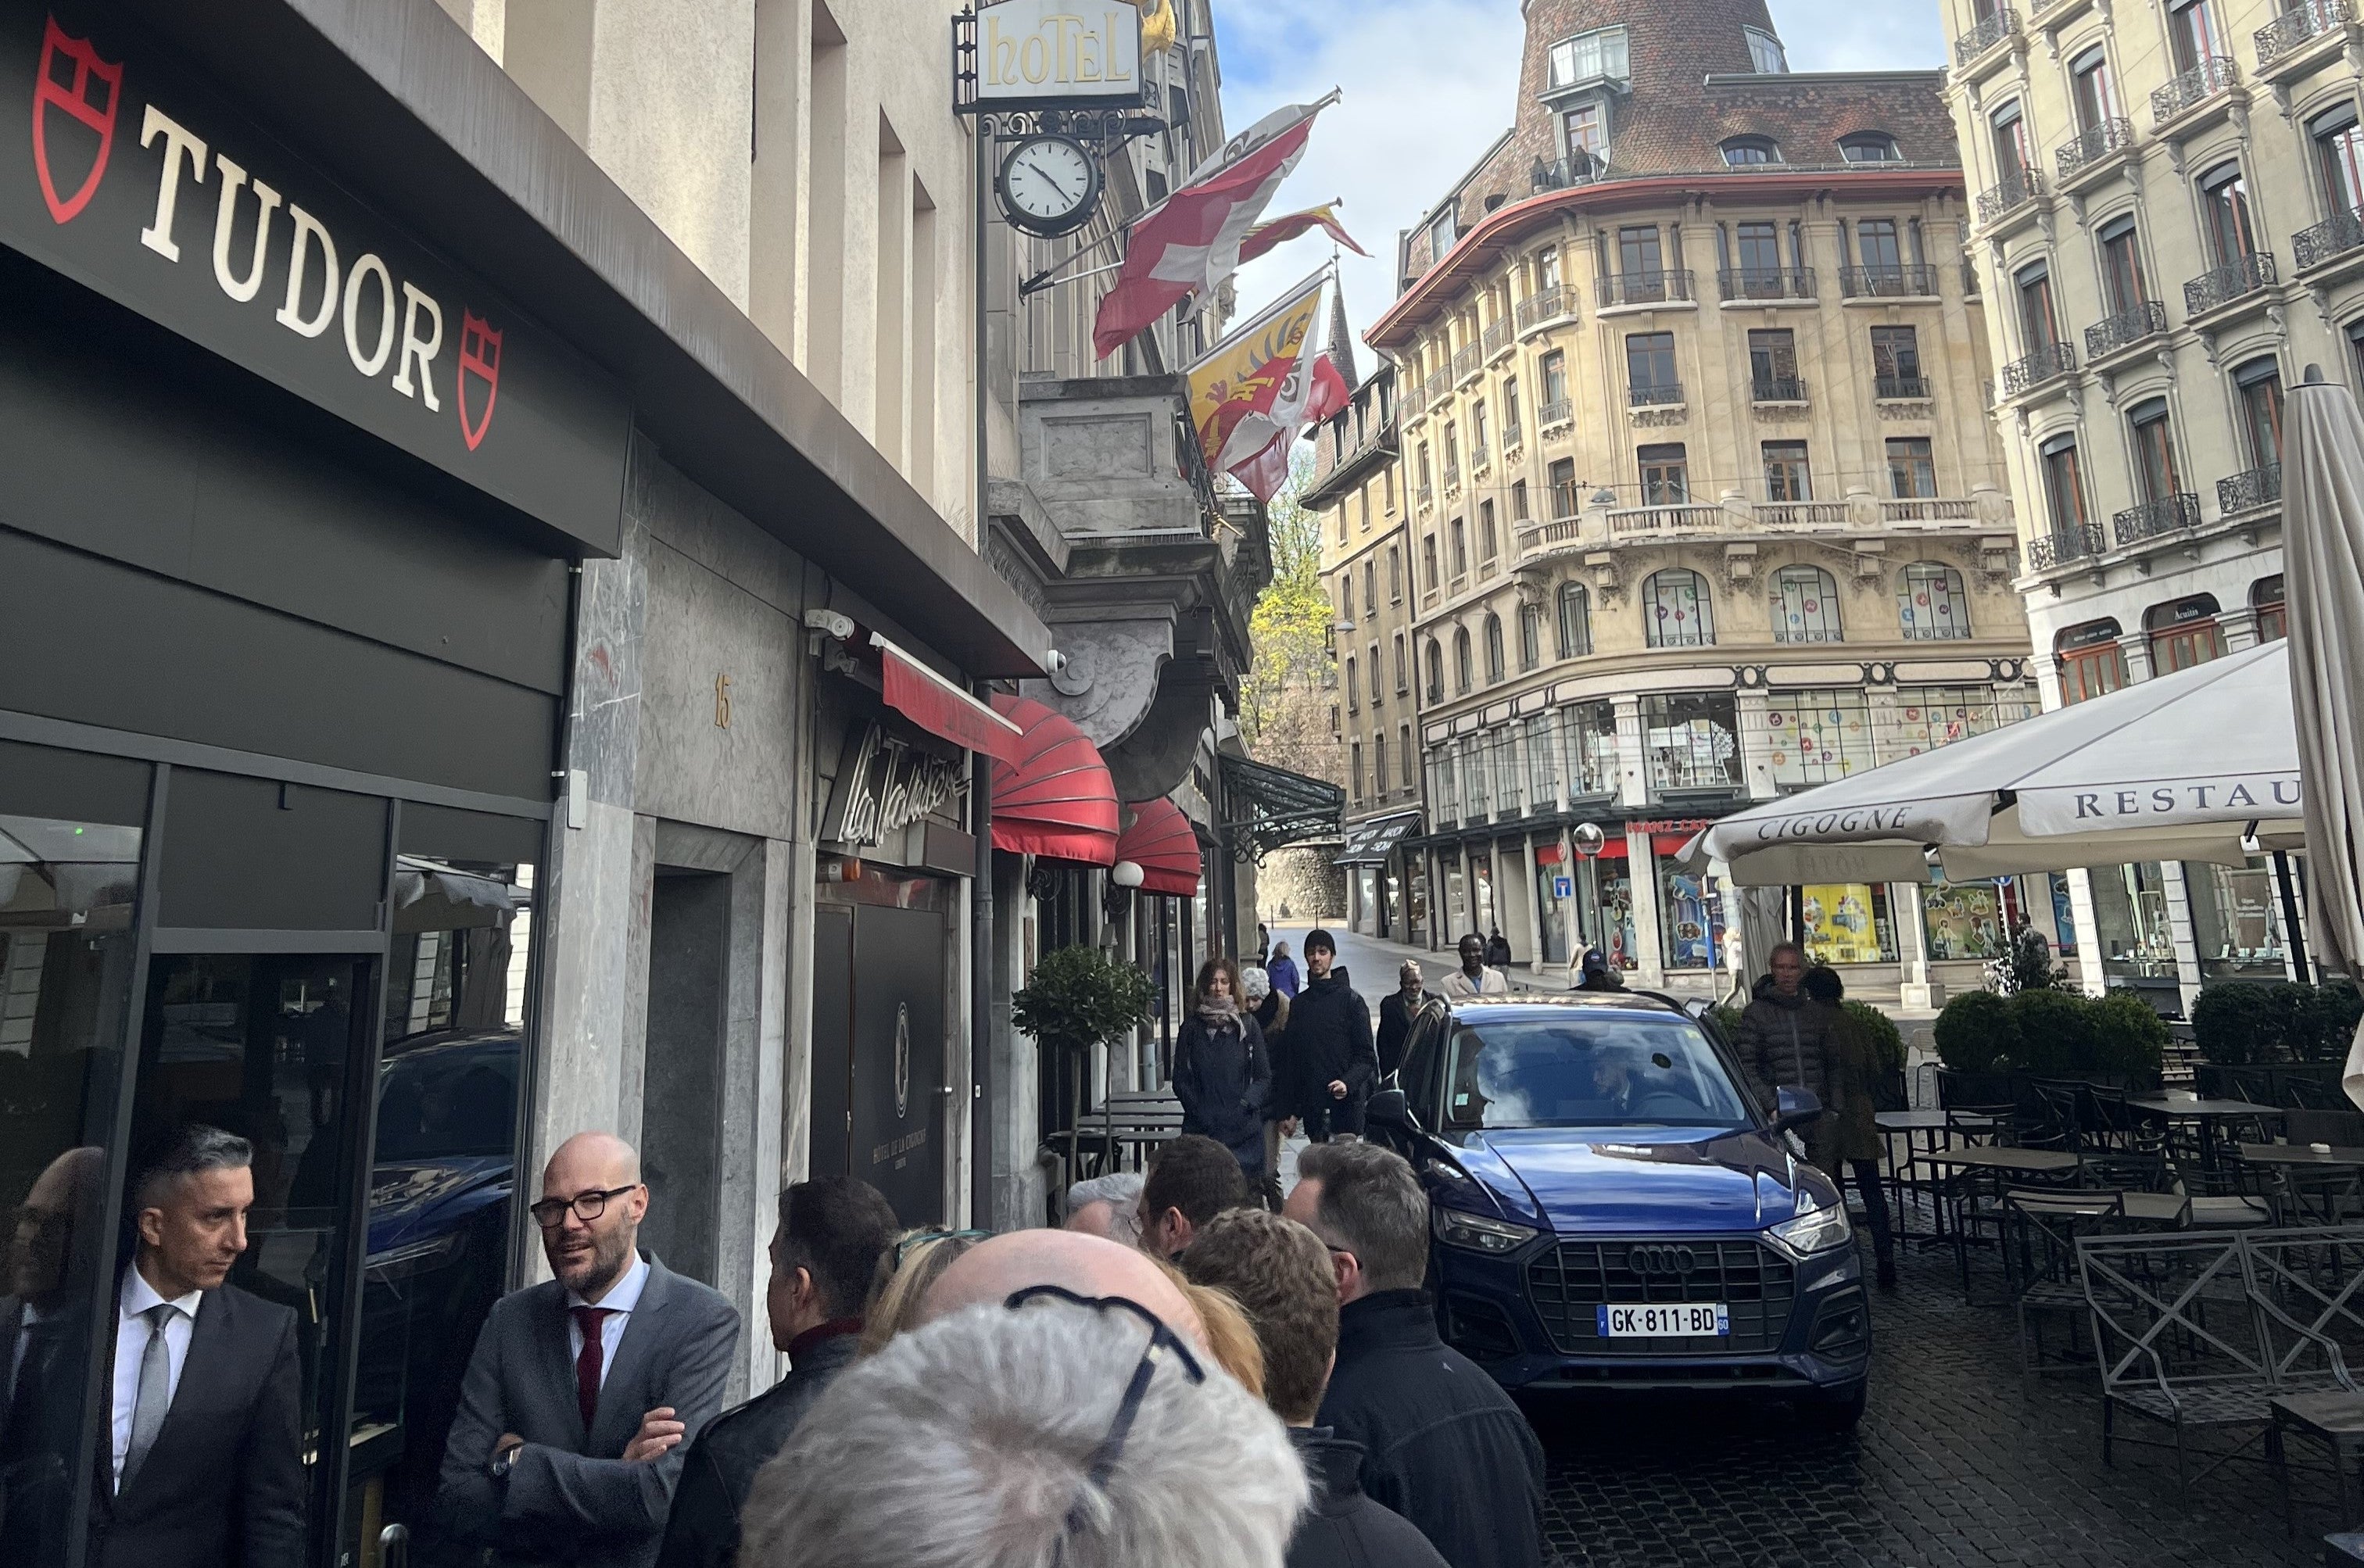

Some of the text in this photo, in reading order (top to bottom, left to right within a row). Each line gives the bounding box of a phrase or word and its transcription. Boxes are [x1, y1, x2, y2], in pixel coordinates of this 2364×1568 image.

[139, 103, 443, 413] TUDOR
[2175, 607, 2199, 620] Acuitis
[715, 672, 733, 729] 15
[1757, 806, 1913, 840] CIGOGNE
[1612, 1308, 1715, 1332] GK-811-BD
[1718, 1319, 1729, 1330] 60
